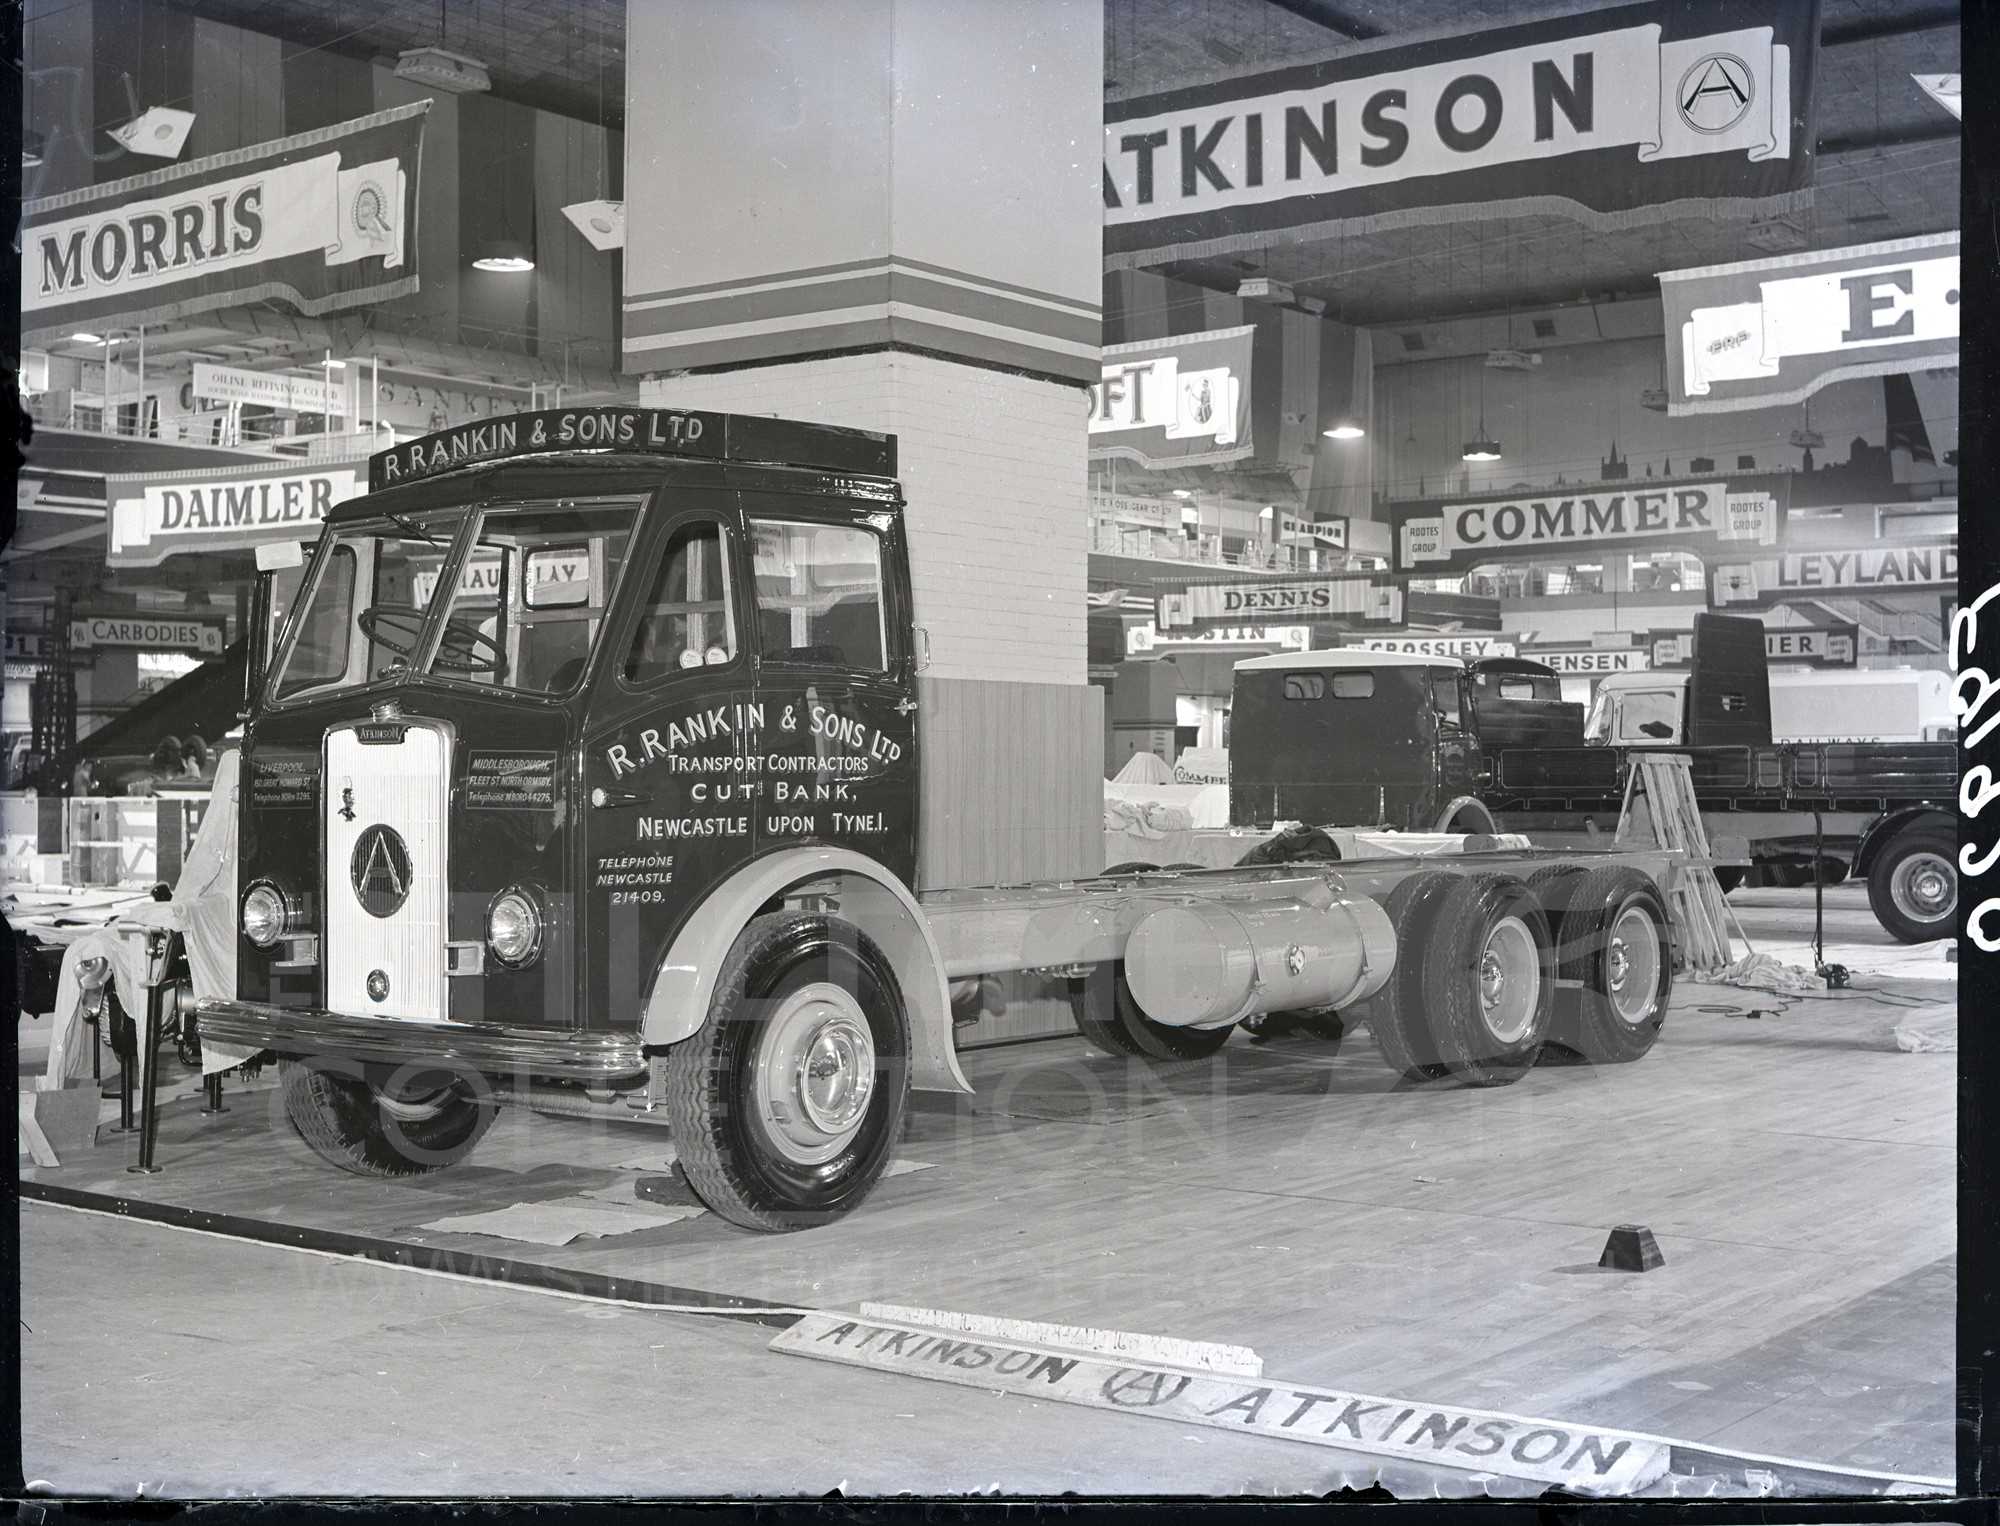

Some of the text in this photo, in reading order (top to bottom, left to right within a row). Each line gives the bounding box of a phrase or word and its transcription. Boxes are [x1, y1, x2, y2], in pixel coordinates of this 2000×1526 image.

[40, 187, 262, 293] MORRIS
[1710, 331, 1748, 355] ERF
[532, 419, 547, 444] &
[559, 413, 634, 442] SONS
[160, 478, 333, 530] DAIMLER
[1730, 501, 1765, 514] ROOTES
[1455, 489, 1712, 544] COMMER
[1732, 519, 1763, 531] GROUP
[1410, 525, 1440, 537] ROOTES
[1411, 542, 1437, 554] GROUP
[1778, 548, 1959, 587] LEYLAND
[1224, 587, 1330, 611] DENNIS
[92, 620, 199, 643] CARBODIES
[780, 705, 798, 730] &
[812, 706, 866, 748] SONS
[668, 753, 869, 772] TRANSPORT CONTRACTORS
[469, 775, 491, 785] FLEET
[500, 775, 523, 786] NORTH
[469, 791, 504, 806] Telephone
[692, 782, 857, 802] CUT BANK,
[638, 816, 748, 838] NEWCASTLE
[768, 816, 815, 833] UPON
[599, 856, 674, 868] TELEPHONE
[597, 872, 673, 885] NEWCASTLE
[612, 890, 666, 903] 21409.
[815, 1321, 1080, 1384] ATKINSON
[1205, 1387, 1632, 1475] ATKINSON
